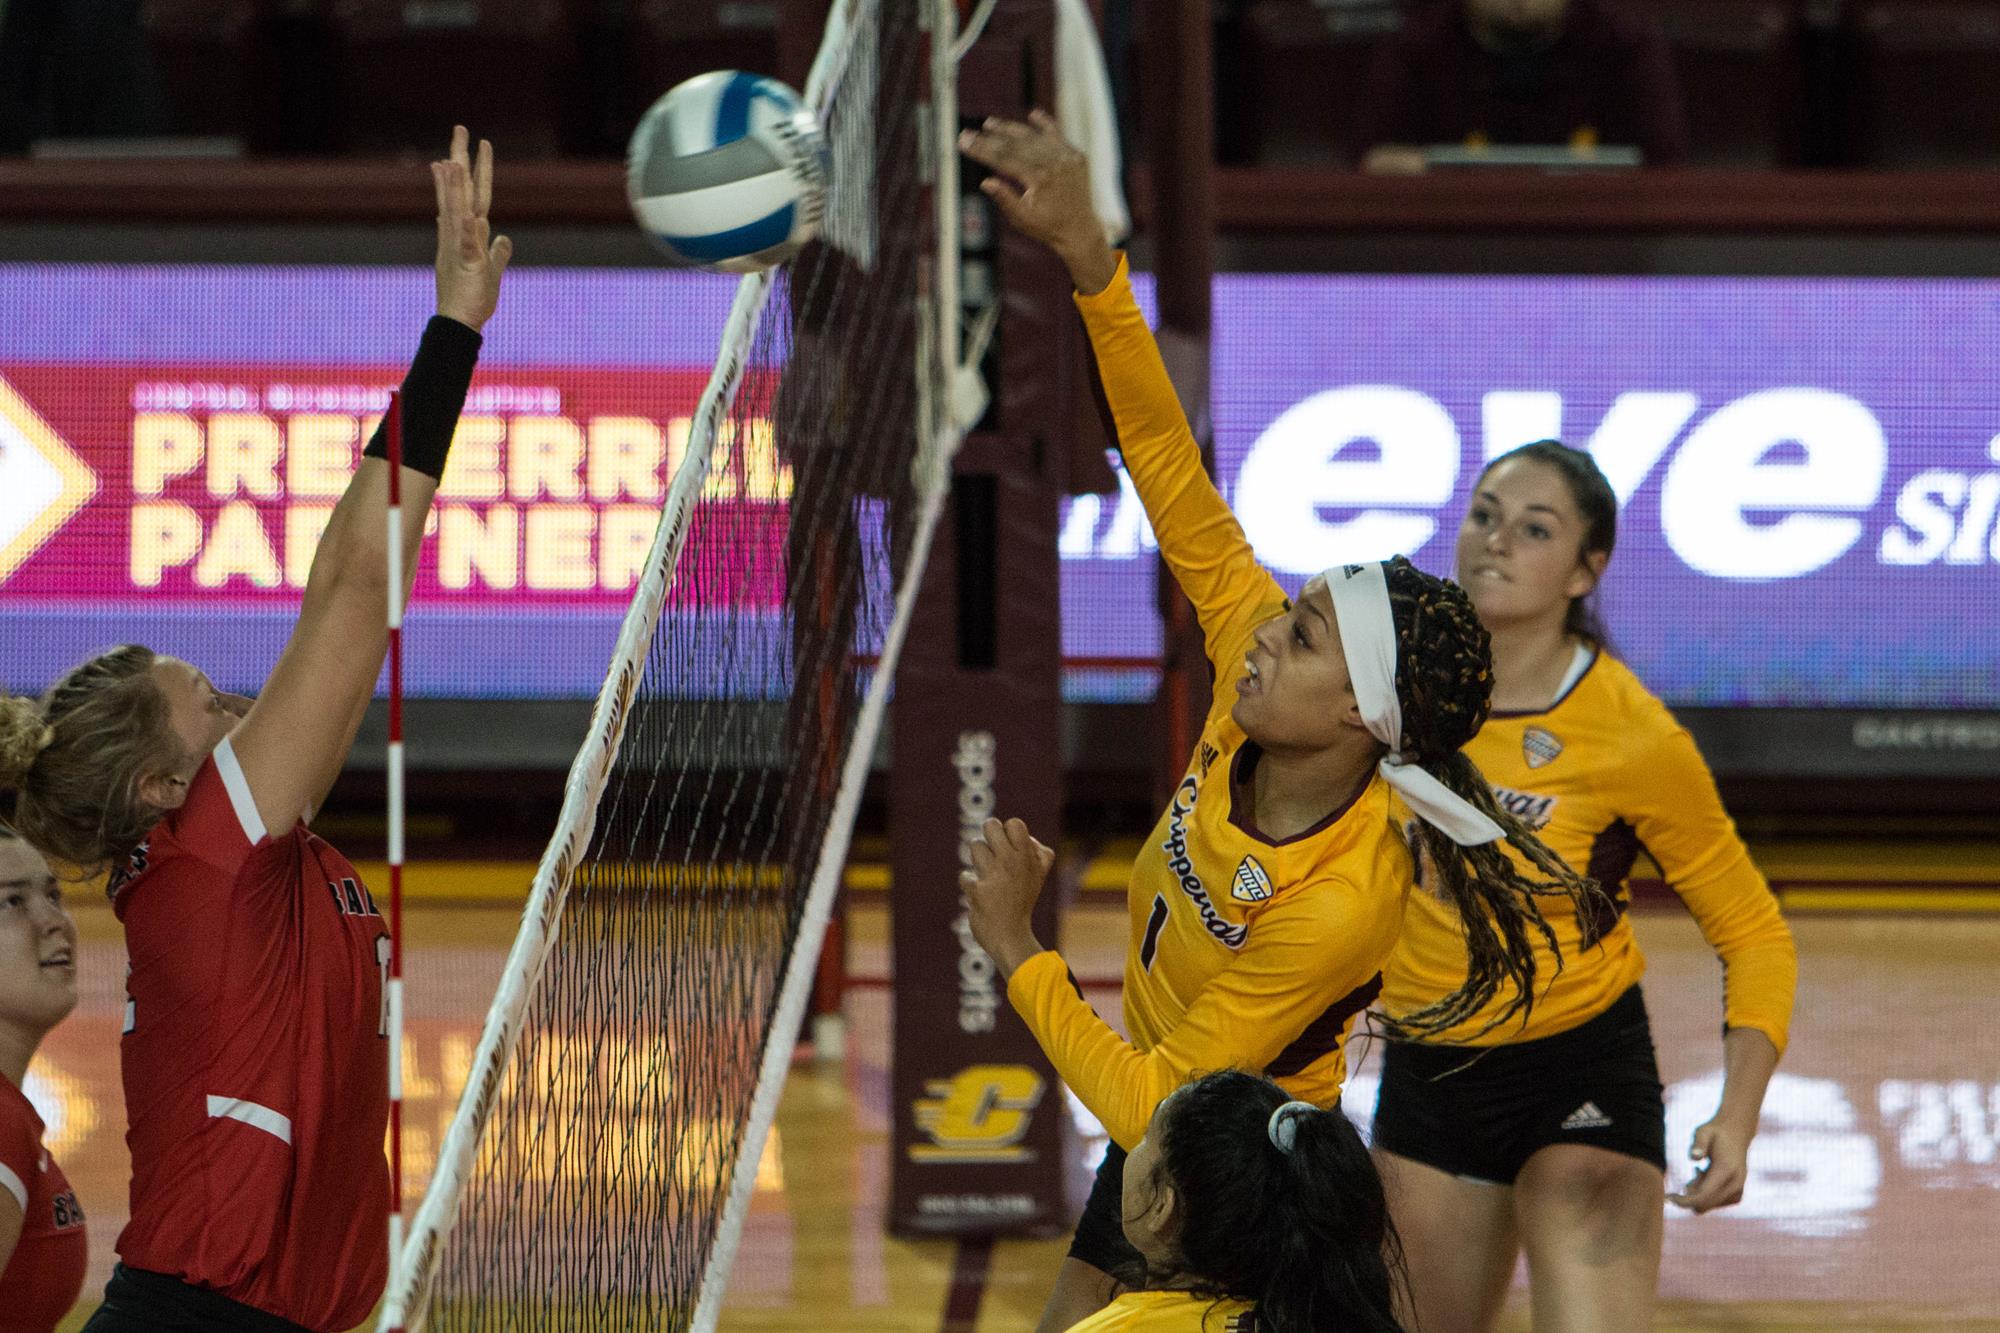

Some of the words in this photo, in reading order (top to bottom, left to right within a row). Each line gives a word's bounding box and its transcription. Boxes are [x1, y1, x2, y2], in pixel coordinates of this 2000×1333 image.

[129, 500, 665, 592] PANER
[1877, 432, 2000, 566] si
[1162, 774, 1249, 949] Chippewas
[1140, 891, 1169, 976] 1
